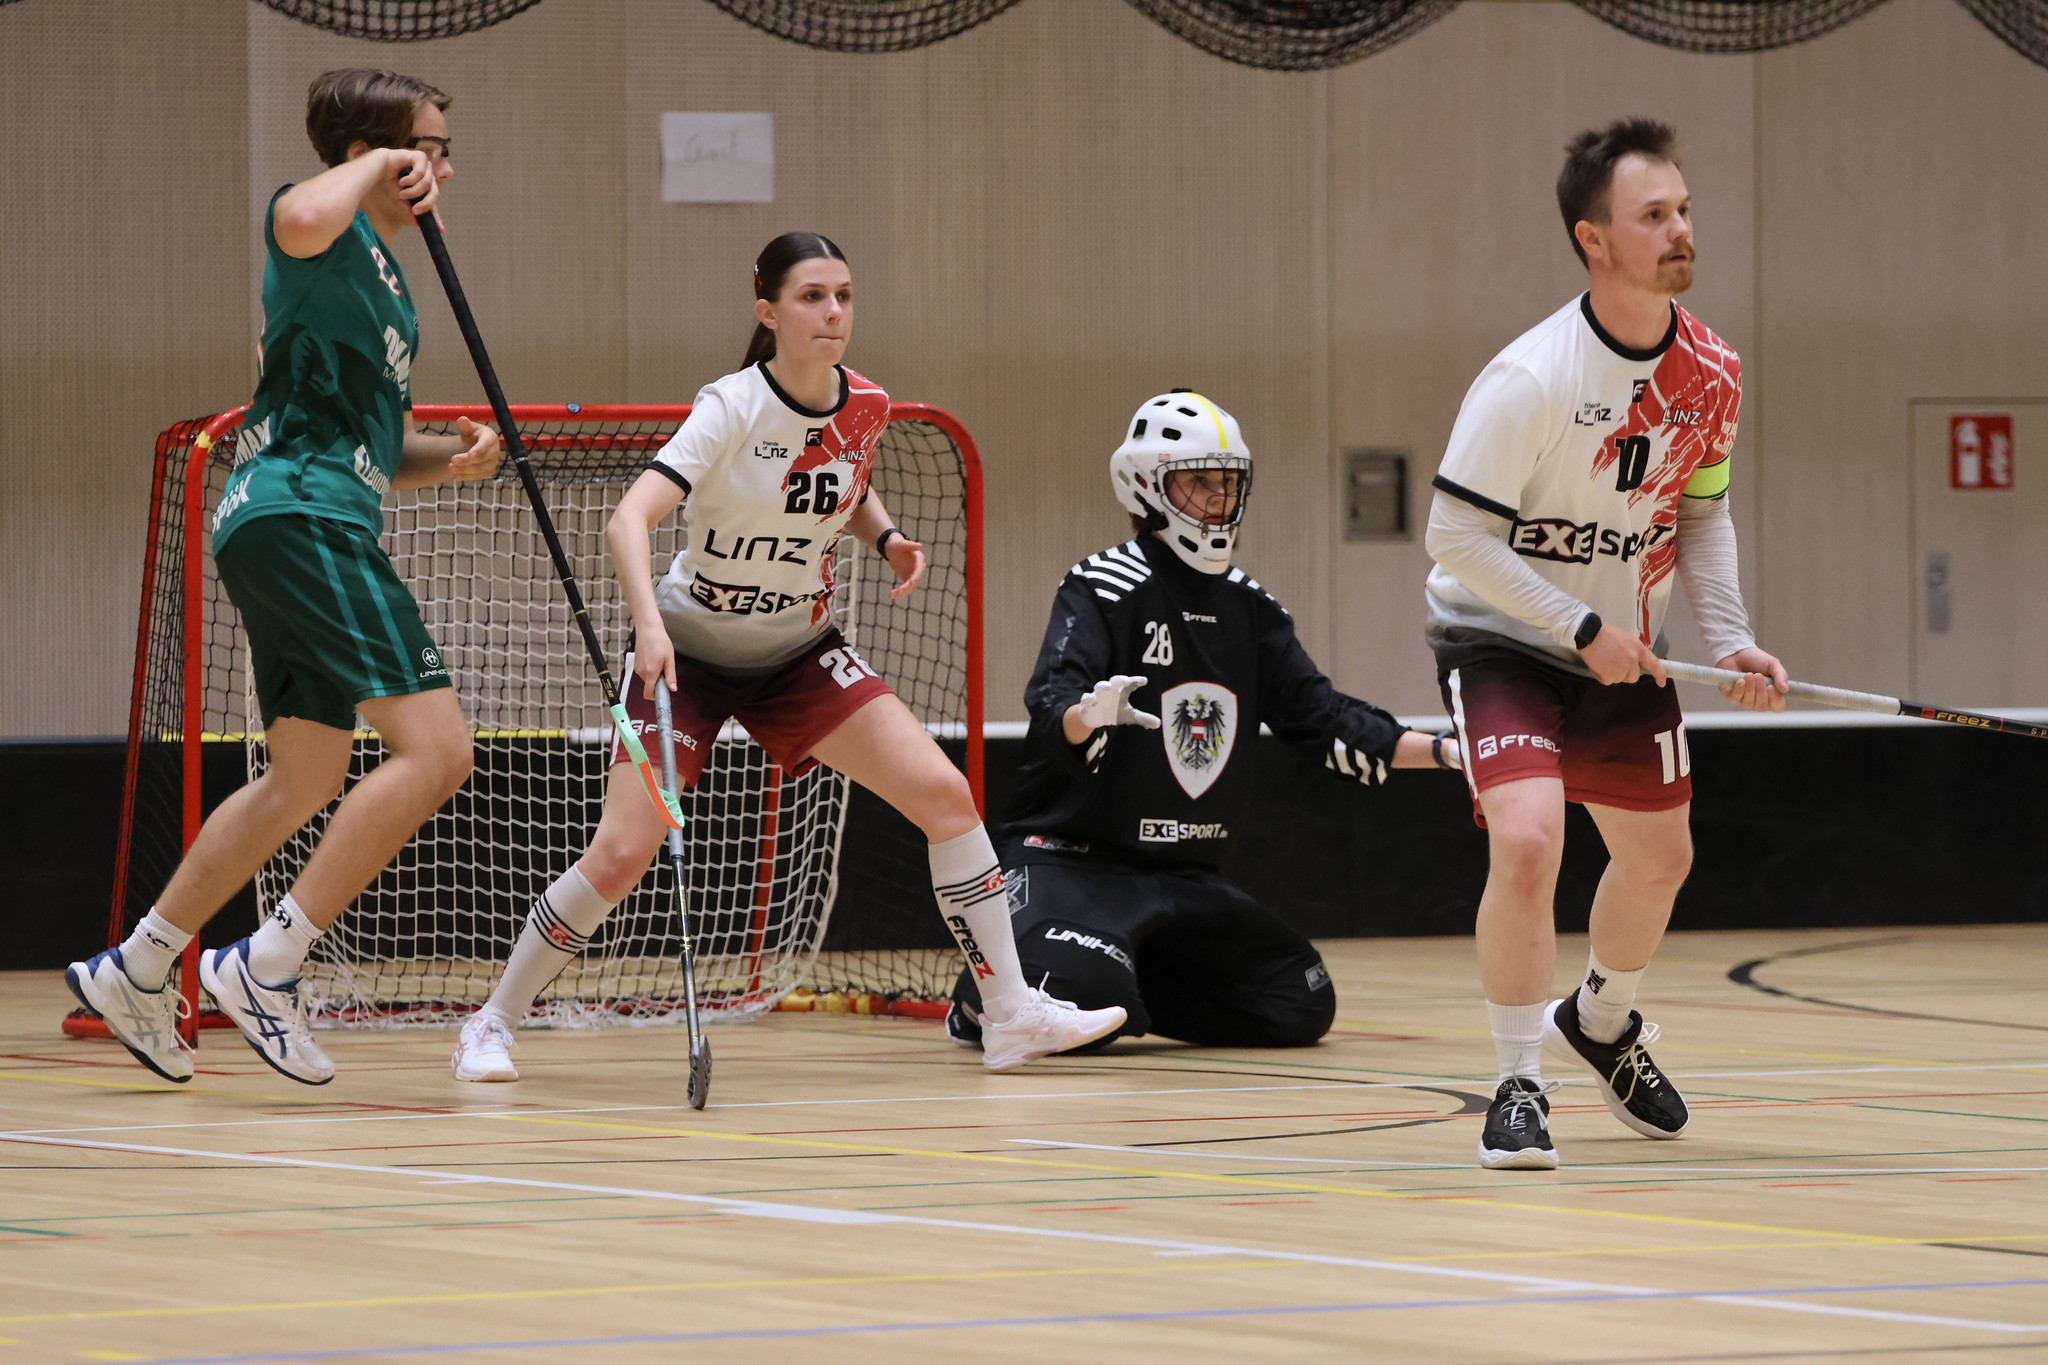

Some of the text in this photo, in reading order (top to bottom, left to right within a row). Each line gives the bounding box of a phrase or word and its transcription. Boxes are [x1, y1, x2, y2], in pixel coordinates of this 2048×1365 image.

[784, 471, 839, 515] 26
[1142, 621, 1174, 666] 28
[645, 724, 698, 752] Feez
[1937, 711, 1991, 728] Freez
[1500, 735, 1561, 753] Freez
[1654, 721, 1691, 785] 10
[947, 915, 995, 980] Freez
